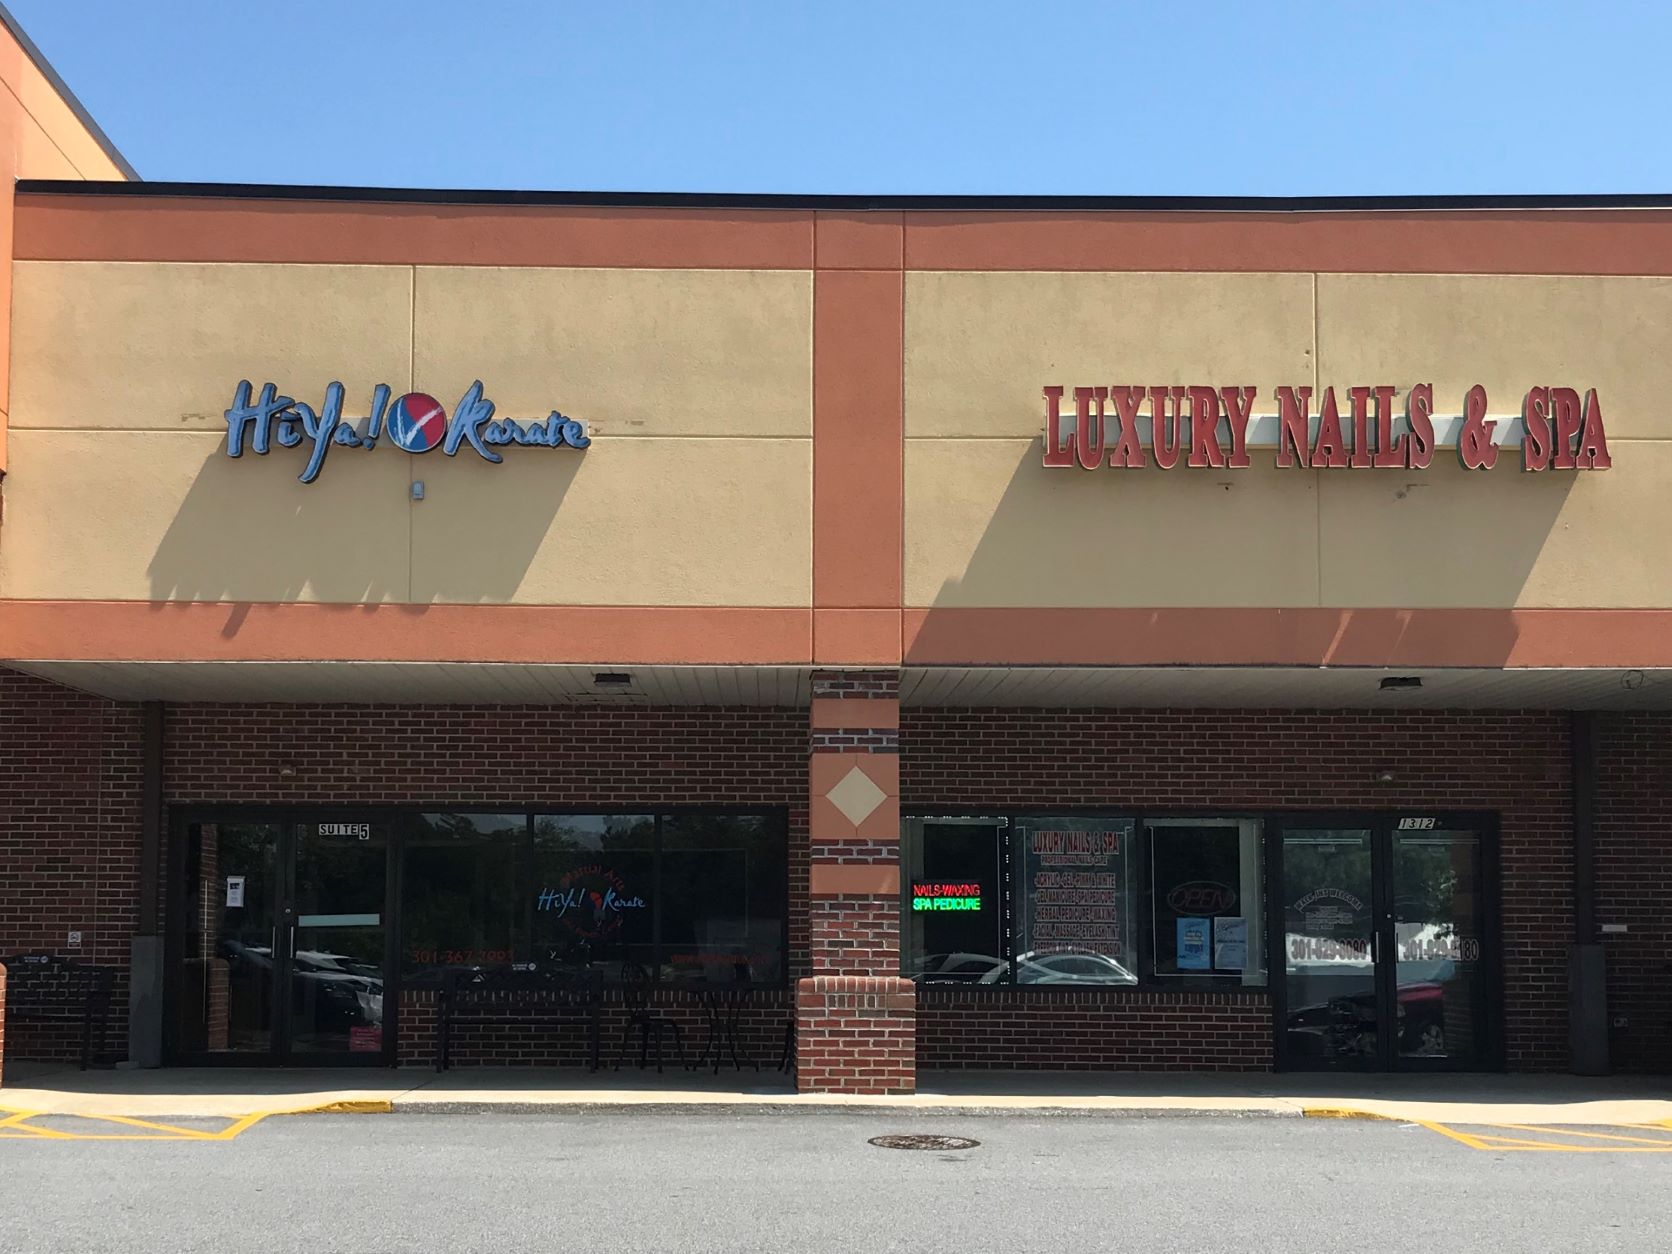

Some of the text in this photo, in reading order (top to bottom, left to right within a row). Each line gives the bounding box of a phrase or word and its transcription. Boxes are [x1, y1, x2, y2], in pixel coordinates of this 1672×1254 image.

[225, 379, 591, 484] HiYa! Karate
[1042, 383, 1612, 471] LUXURY NAILS & SPA
[319, 824, 369, 839] SUITE 5
[1400, 818, 1435, 829] 1312
[1033, 831, 1119, 854] LUXURY NAILS & SPA
[538, 887, 647, 918] HiYa! Karate
[913, 898, 981, 911] SPA PEDICURE
[1171, 888, 1226, 908] OPEN
